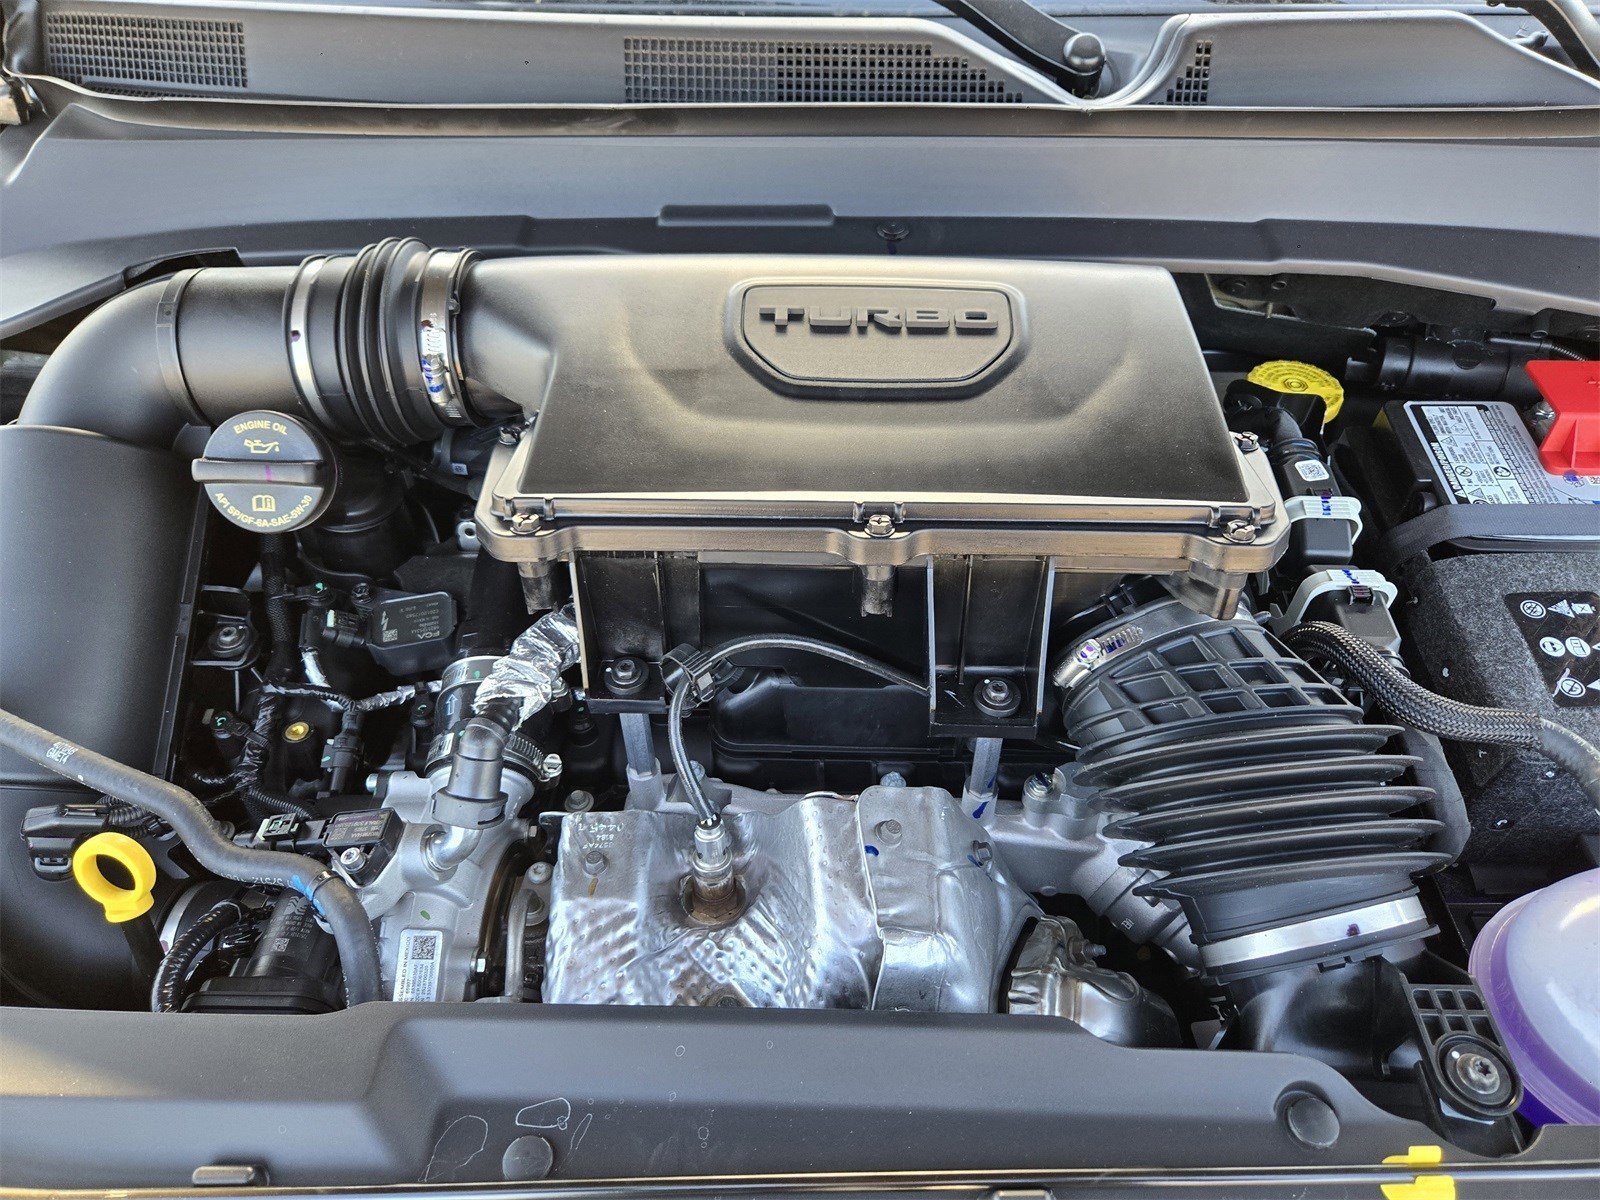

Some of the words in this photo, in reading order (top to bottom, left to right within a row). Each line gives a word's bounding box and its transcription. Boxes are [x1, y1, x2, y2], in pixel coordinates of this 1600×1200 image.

[759, 307, 998, 331] TURBO
[233, 420, 271, 434] ENGINE
[272, 422, 288, 435] OIL
[215, 492, 231, 508] API
